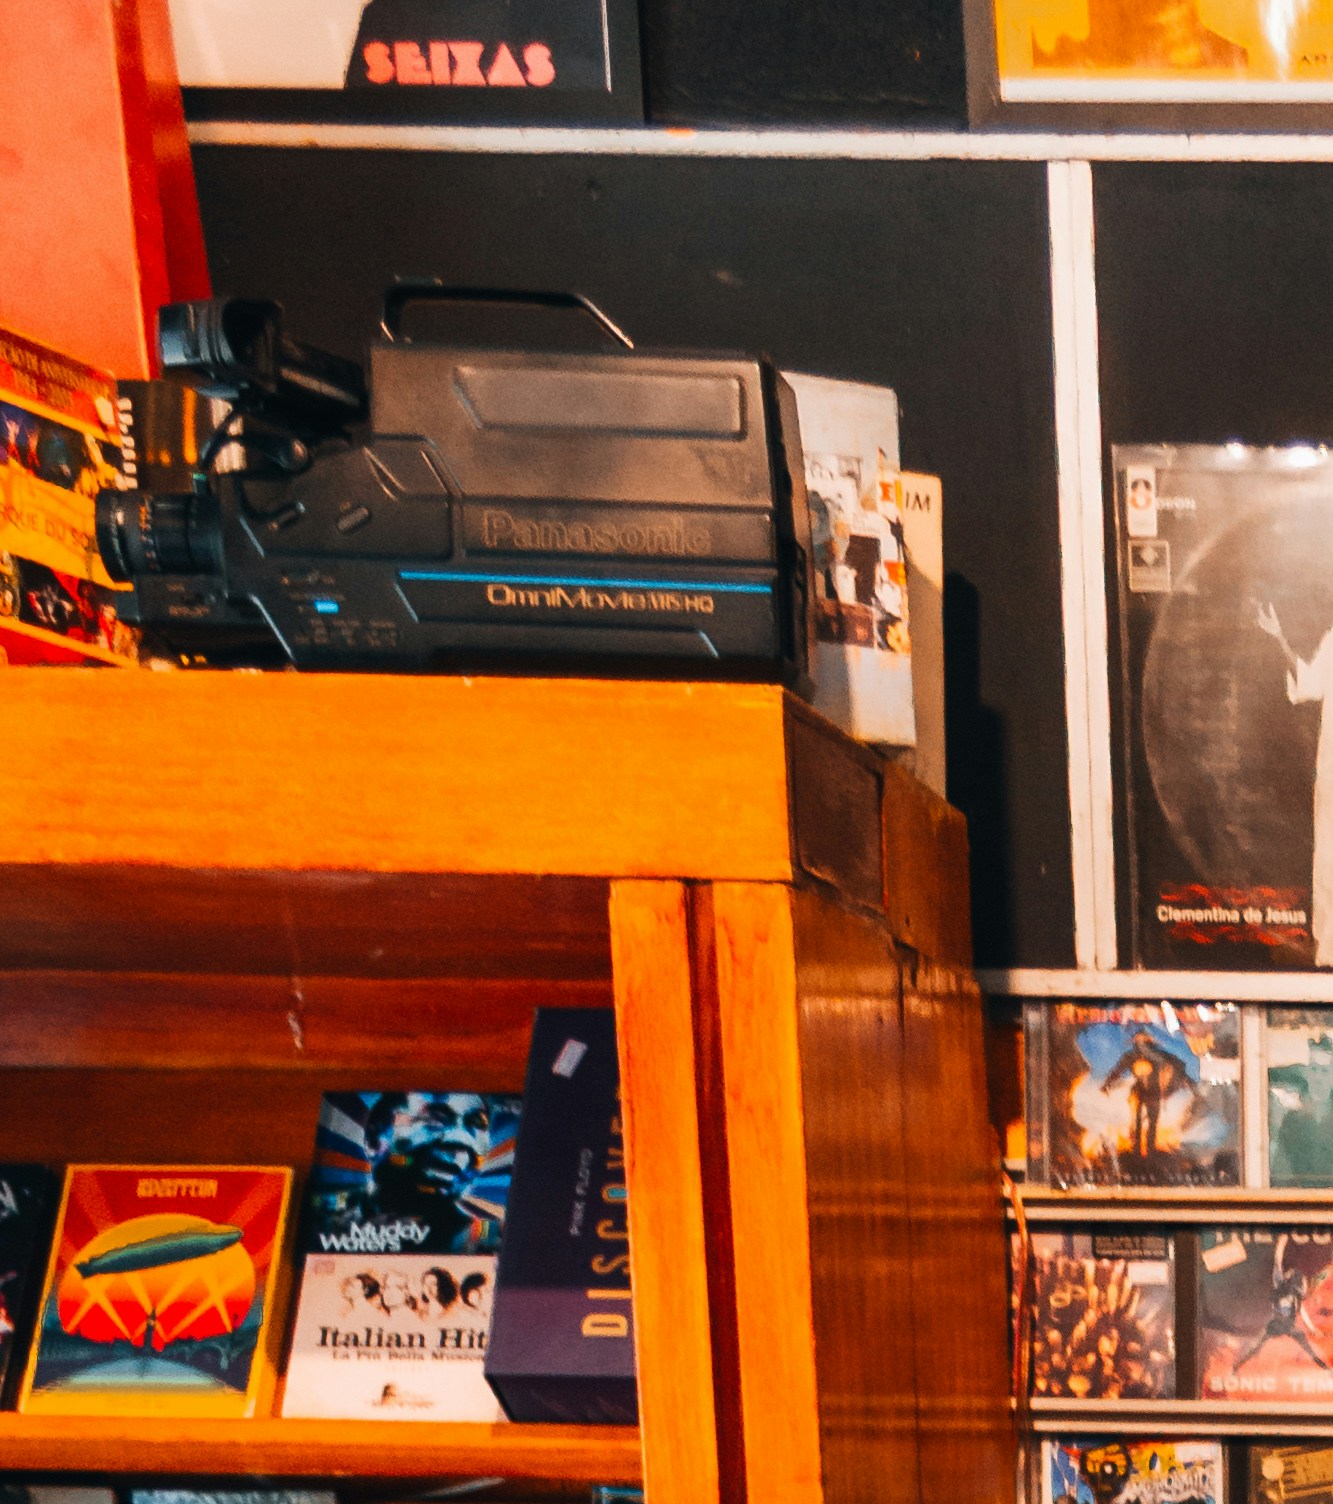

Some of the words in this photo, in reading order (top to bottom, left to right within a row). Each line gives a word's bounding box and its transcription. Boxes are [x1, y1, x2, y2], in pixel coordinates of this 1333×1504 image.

[364, 42, 556, 87] SEIXAS
[483, 509, 713, 557] Panasonic
[486, 585, 648, 610] OmniMovie
[1156, 905, 1240, 924] Clementina
[1243, 905, 1263, 924] de
[1265, 906, 1307, 924] Jesus
[350, 1220, 431, 1244] Muddy
[317, 1326, 427, 1349] Italian
[1210, 1376, 1277, 1393] SONIC
